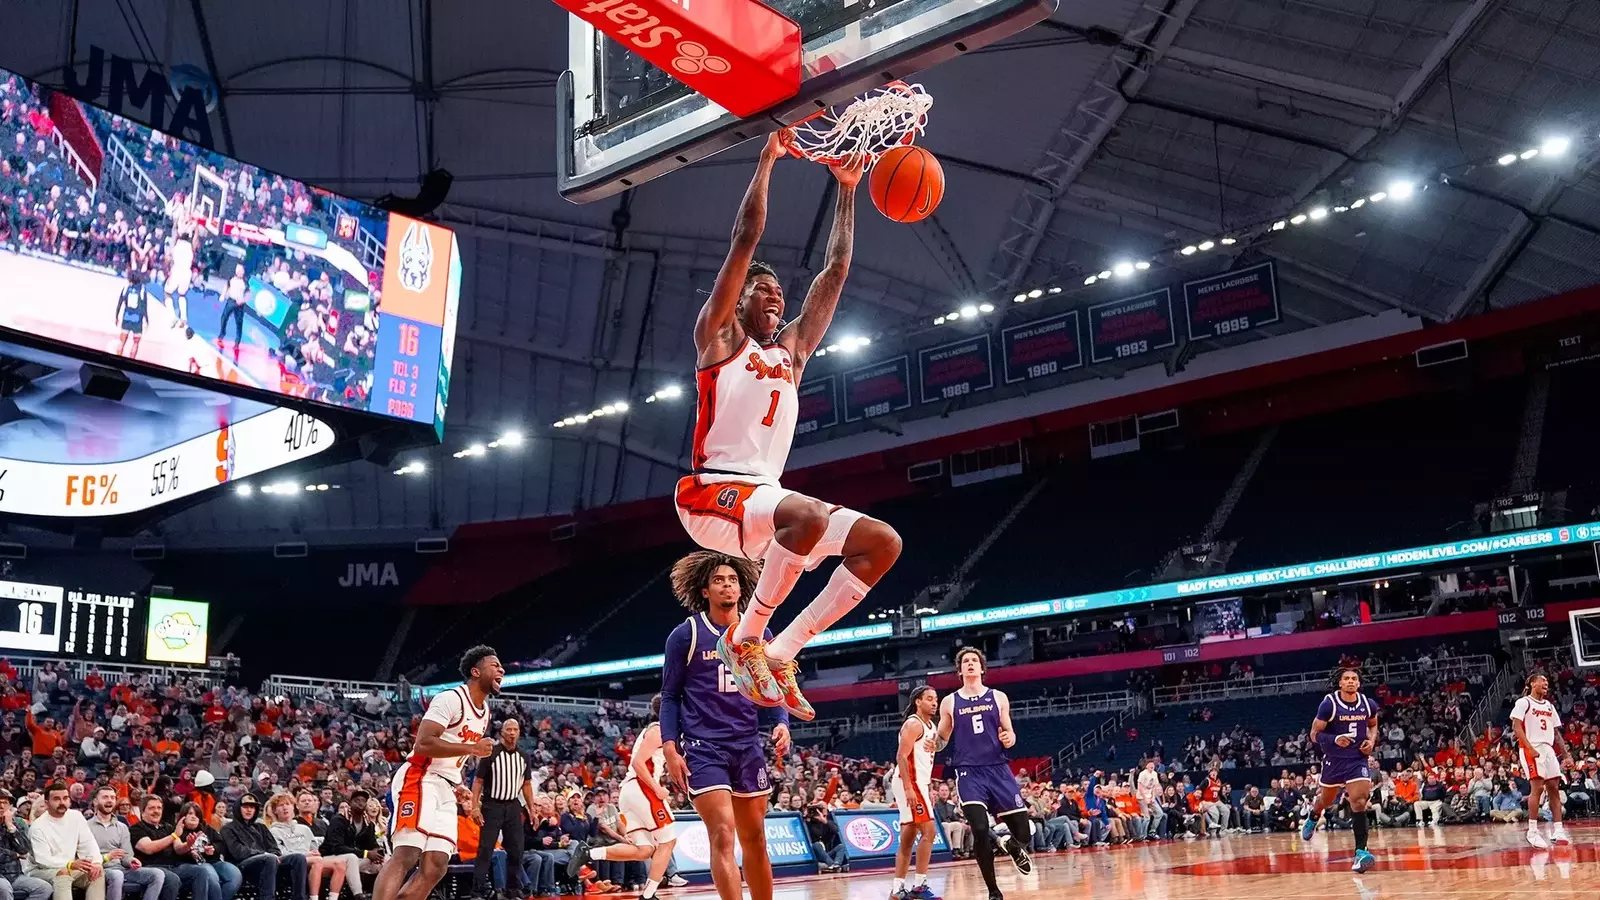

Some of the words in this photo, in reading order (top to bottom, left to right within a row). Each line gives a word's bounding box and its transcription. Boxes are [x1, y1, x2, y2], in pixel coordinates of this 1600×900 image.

[1214, 317, 1249, 335] 1995
[399, 323, 419, 356] 16
[1559, 335, 1581, 347] TEXT
[1115, 340, 1148, 357] 1993
[1027, 361, 1057, 378] 1990
[761, 389, 780, 427] 1
[285, 411, 318, 451] 40%
[150, 455, 180, 496] 55%
[65, 474, 118, 505] FG%
[1497, 497, 1514, 507] 302
[1522, 492, 1540, 502] 303
[1177, 580, 1209, 594] READY
[1208, 578, 1228, 589] FOR
[1227, 574, 1255, 587] YOUR
[1255, 565, 1314, 583] NEXT-LEVEL
[1314, 555, 1381, 575] CHALLENGE?
[1387, 531, 1554, 565] HIDDENLEVEL.COM/#CAREERS
[338, 562, 399, 587] JMA
[18, 602, 43, 635] 16
[1498, 613, 1516, 624] 102
[1526, 608, 1544, 619] 103
[1164, 652, 1176, 661] 101
[1184, 648, 1199, 657] 102
[958, 704, 994, 715] UALBANY
[971, 714, 985, 735] 6
[1348, 722, 1358, 738] 5
[1540, 719, 1547, 731] 3
[401, 801, 415, 817] S
[656, 809, 666, 821] S
[916, 803, 925, 815] S
[773, 840, 809, 856] WASH
